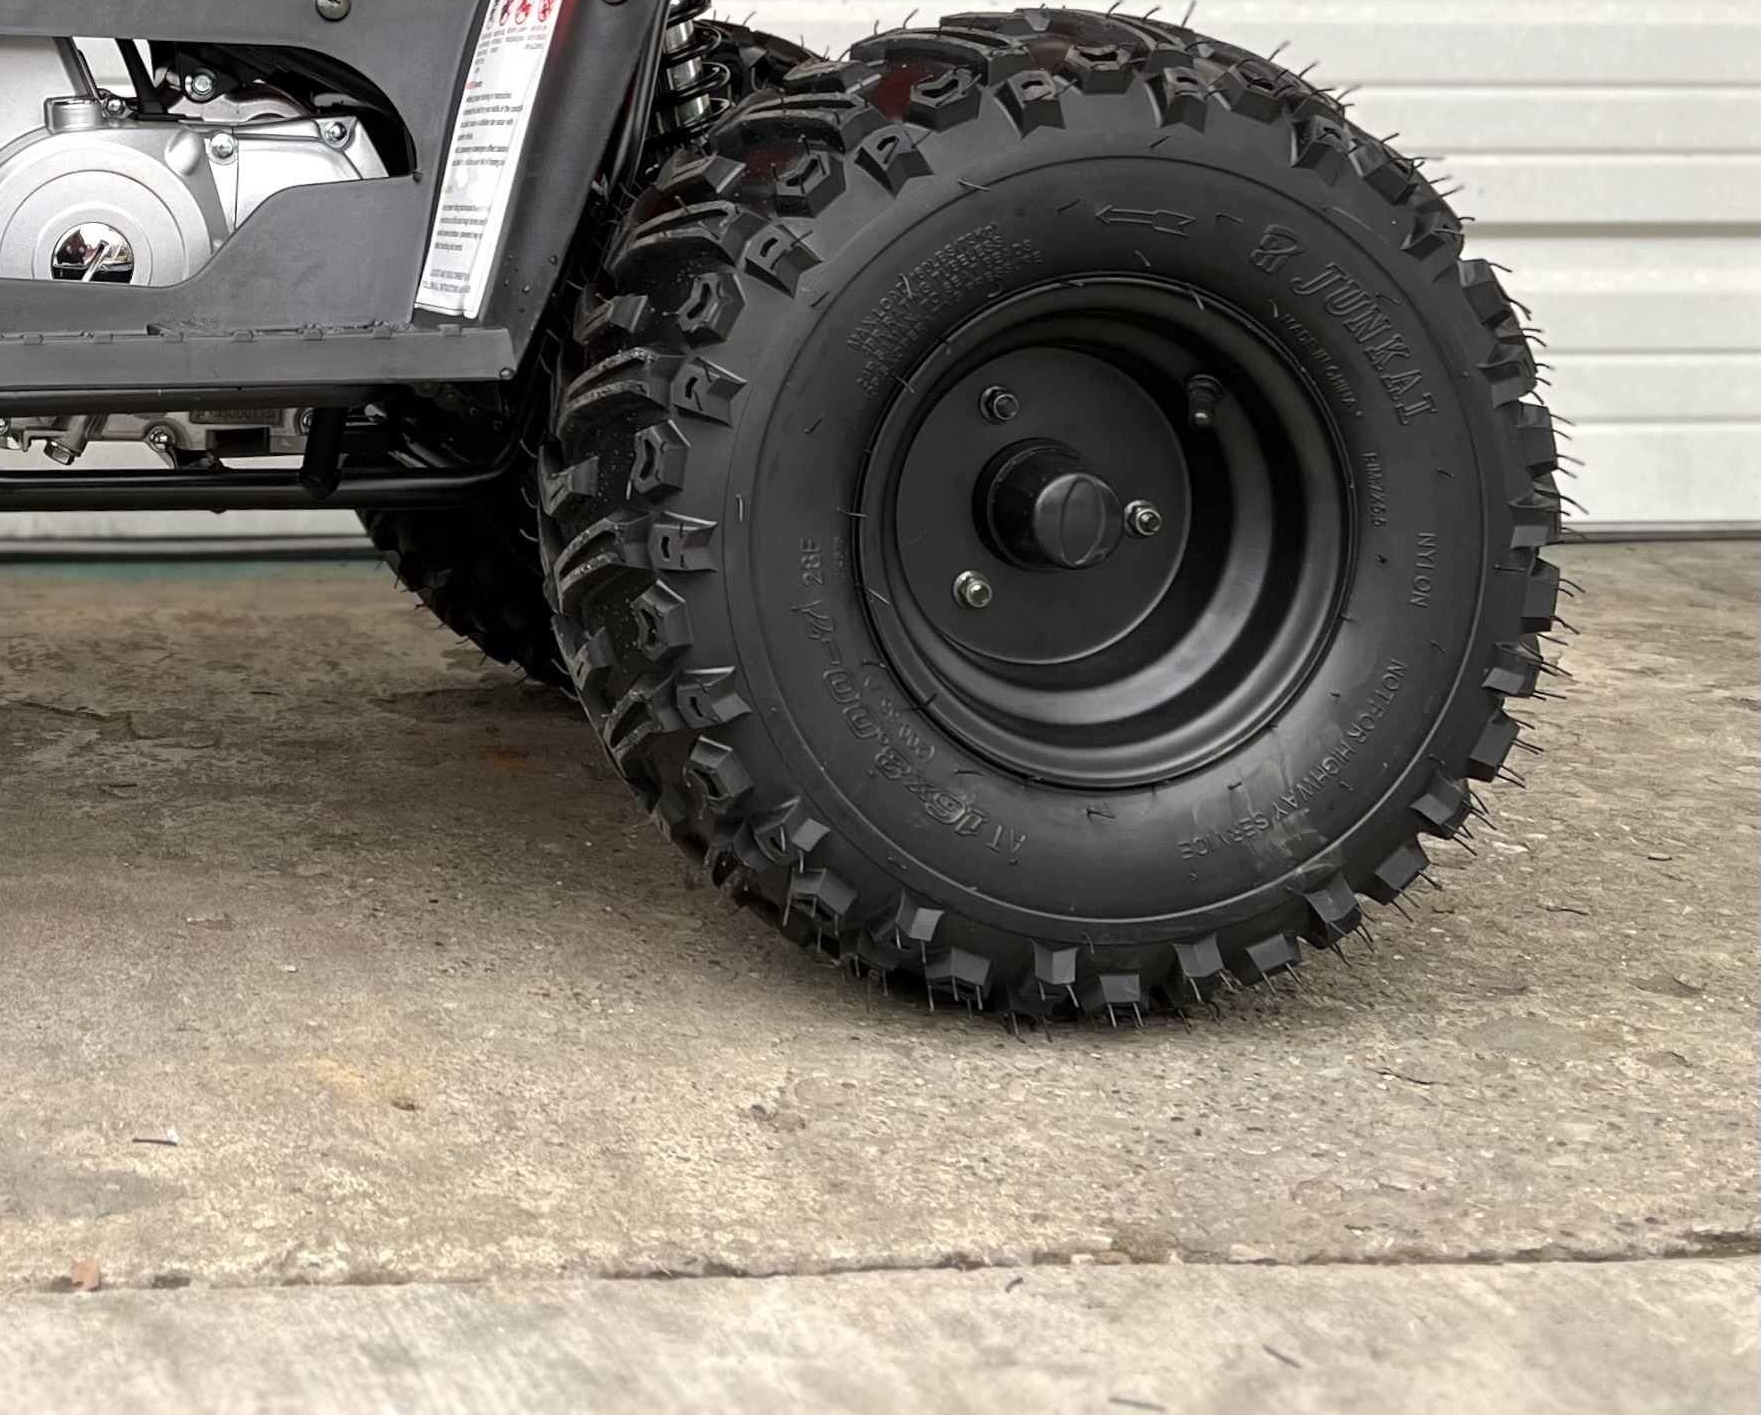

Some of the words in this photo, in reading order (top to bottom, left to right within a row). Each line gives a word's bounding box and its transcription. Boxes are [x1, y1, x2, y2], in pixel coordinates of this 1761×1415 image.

[1291, 262, 1438, 426] JUNKAI
[1408, 531, 1438, 610] NYLON
[1369, 656, 1410, 709] NOT
[1344, 698, 1387, 747] FOR
[1269, 743, 1357, 821] HIGHWAY
[985, 824, 1029, 859] AT
[1176, 812, 1272, 863] SERVICE
